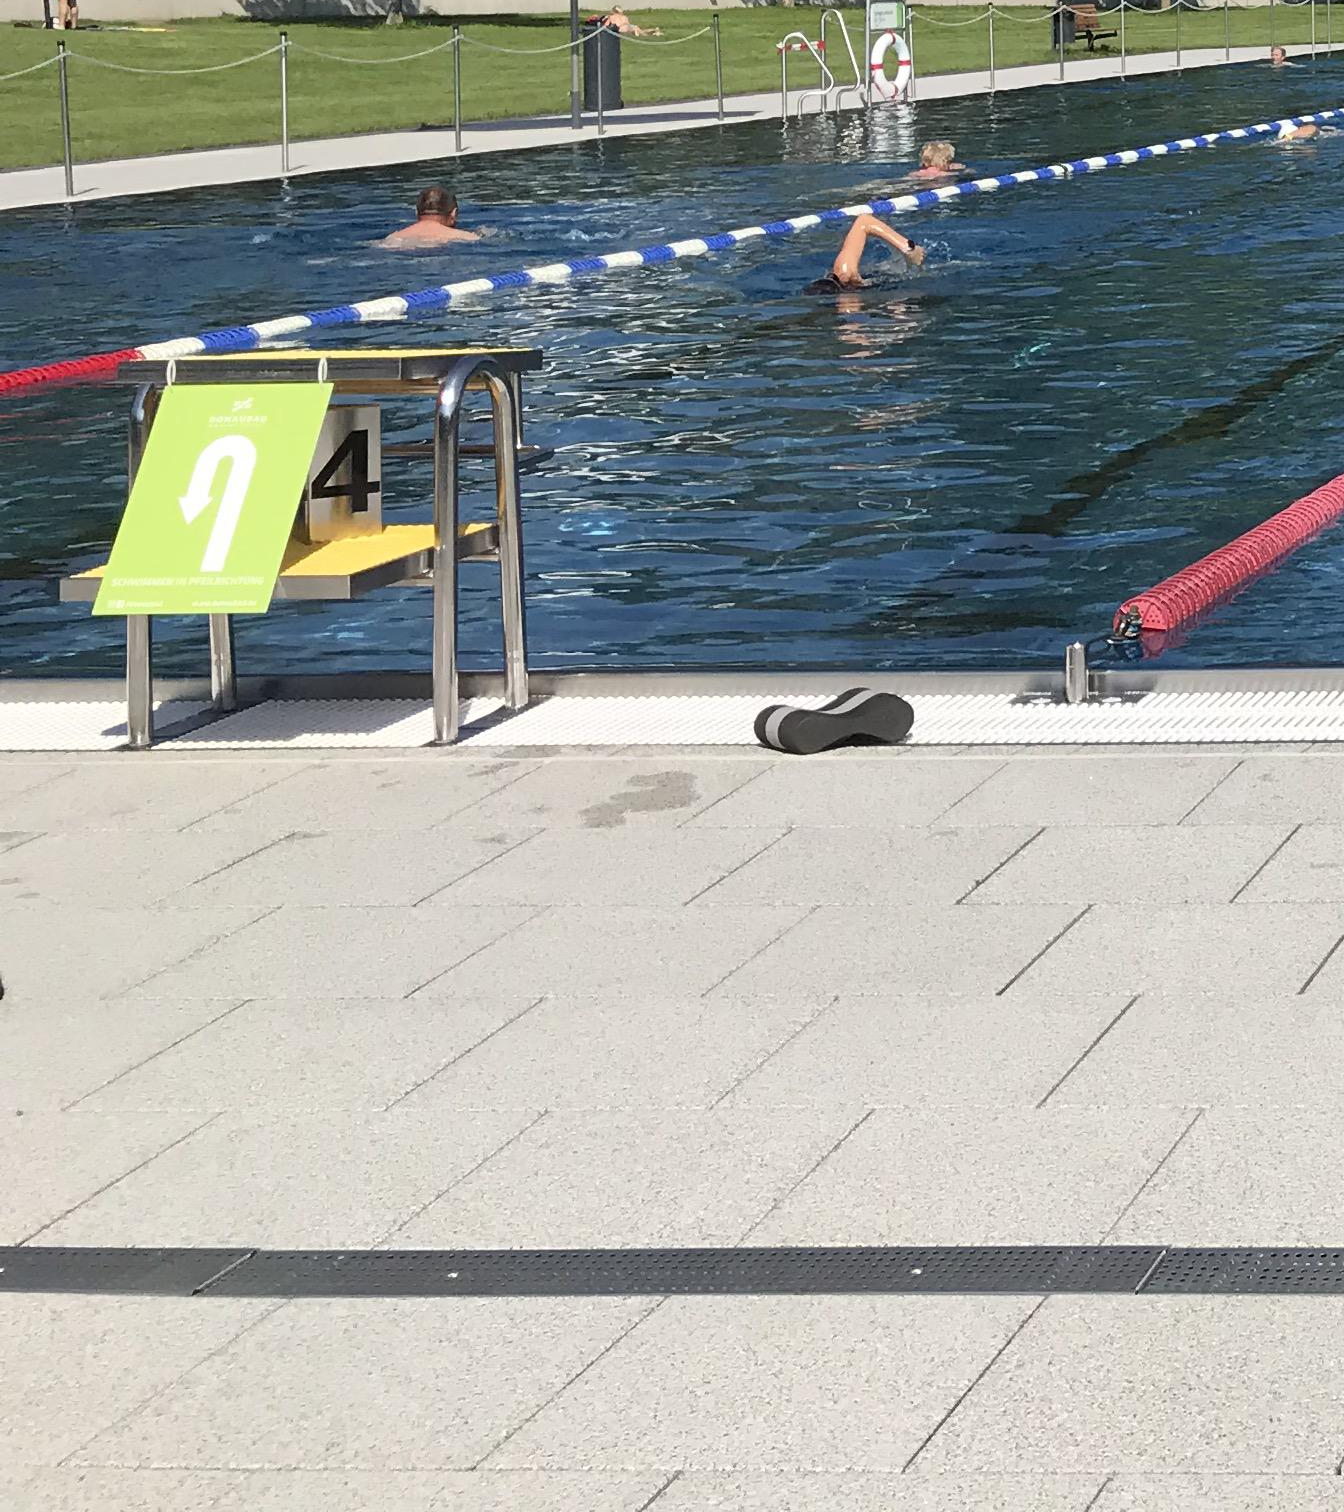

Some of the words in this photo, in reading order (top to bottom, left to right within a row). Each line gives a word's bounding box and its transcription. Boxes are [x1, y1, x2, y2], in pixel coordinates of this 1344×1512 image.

[310, 429, 381, 513] 4
[111, 577, 174, 588] SCHWIMMEN
[188, 575, 264, 586] PFEILRICHTUNG
